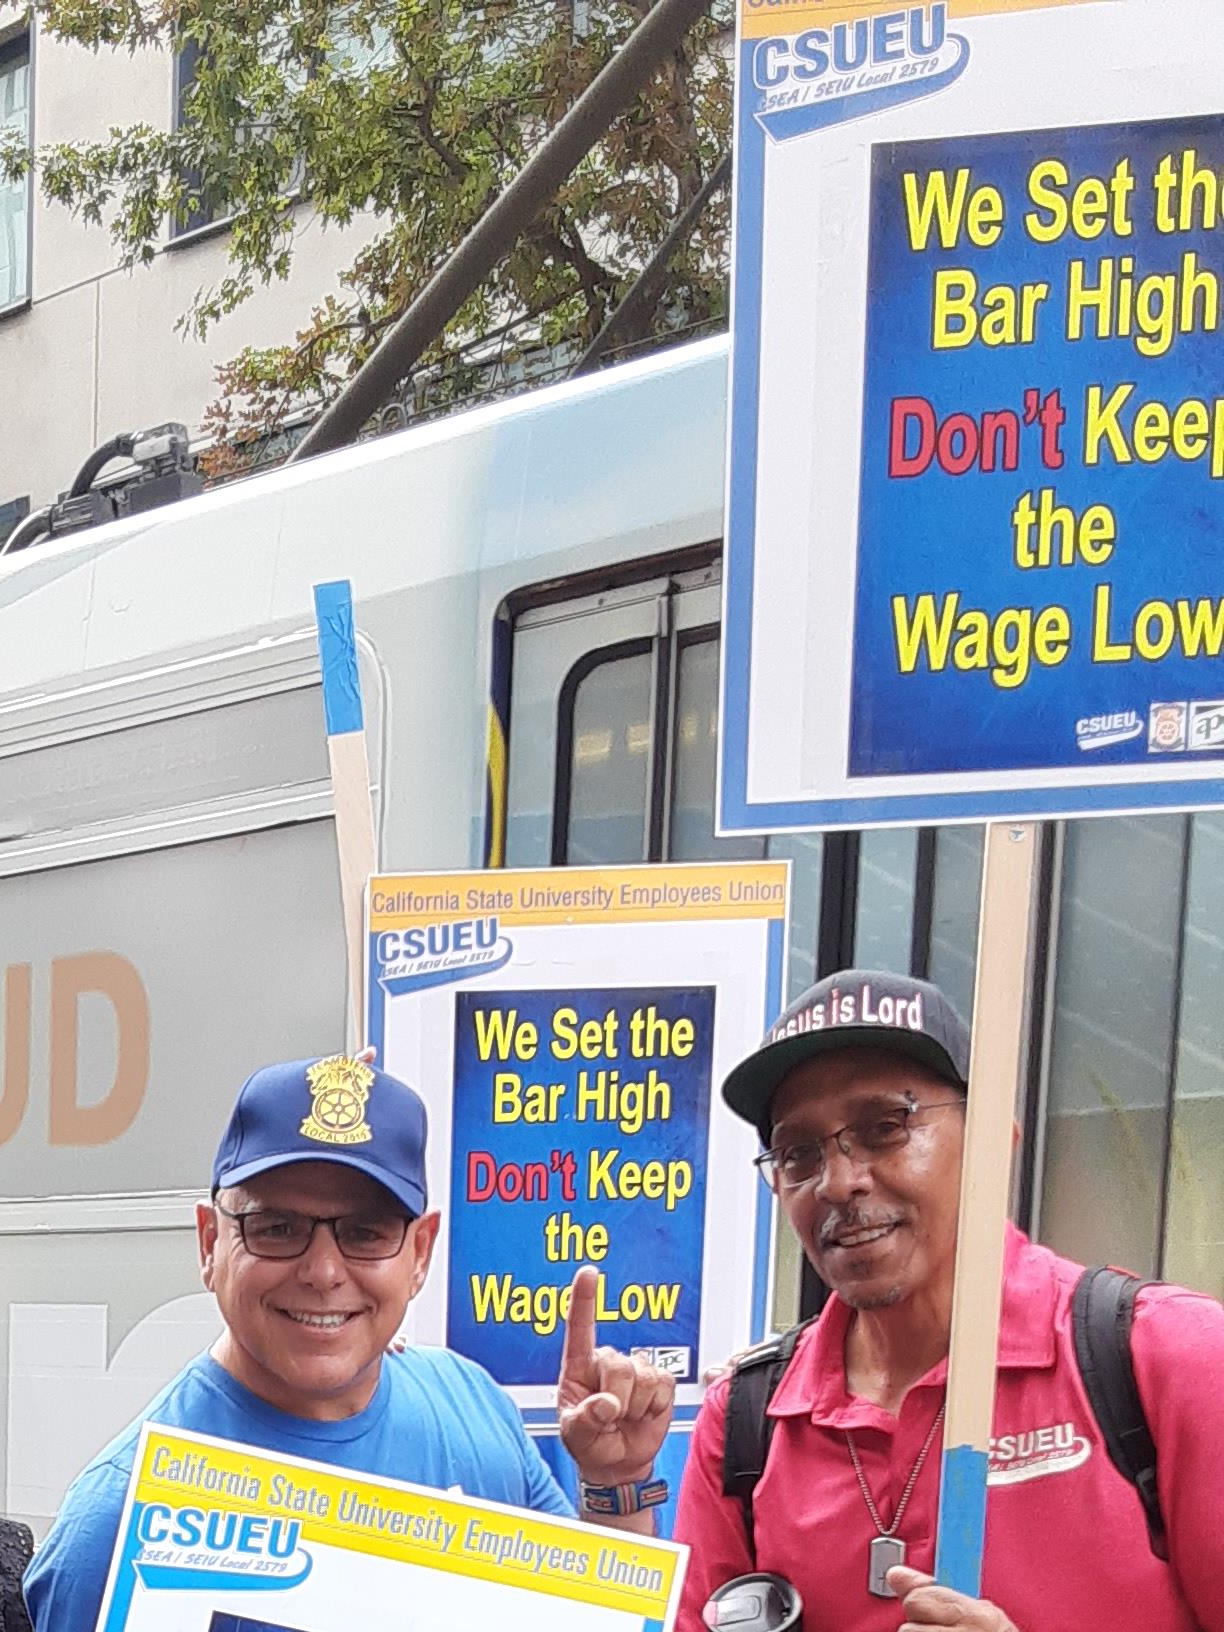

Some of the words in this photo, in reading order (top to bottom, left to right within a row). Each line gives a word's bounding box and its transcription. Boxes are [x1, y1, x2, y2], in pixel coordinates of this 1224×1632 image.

[755, 3, 946, 87] CSUEU
[814, 75, 856, 98] SEIU
[857, 65, 894, 88] Local
[898, 57, 939, 78] 2579
[901, 167, 1004, 252] We
[1024, 155, 1135, 244] Set
[1152, 148, 1224, 235] th
[931, 268, 1048, 350] Bar
[1067, 251, 1218, 357] High
[887, 388, 1066, 479] Don't
[1011, 487, 1117, 569] the
[890, 591, 1070, 689] Wage
[1091, 582, 1224, 664] Low
[1076, 710, 1137, 735] CSUEU
[372, 890, 460, 914] California
[466, 889, 514, 910] State
[520, 885, 614, 910] University
[620, 882, 723, 908] Employees
[728, 880, 785, 902] Union
[378, 917, 498, 962] CSUEU
[474, 1009, 537, 1062] We
[549, 1006, 619, 1061] Set
[631, 1002, 696, 1058] the
[831, 988, 856, 1025] is
[862, 985, 923, 1030] Lord
[493, 1072, 566, 1125] Bar
[578, 1069, 671, 1134] High
[466, 1150, 577, 1202] Don't
[587, 1148, 692, 1211] Keep
[544, 1211, 609, 1262] the
[596, 1272, 682, 1323] Low
[140, 1504, 301, 1559] CSUEU
[151, 1444, 262, 1502] California
[267, 1473, 330, 1517] State
[337, 1489, 459, 1553] University
[463, 1518, 591, 1575] Employees
[596, 1547, 664, 1592] Union
[186, 1552, 220, 1567] SEIU
[219, 1555, 251, 1571] Local
[253, 1560, 289, 1574] 2579
